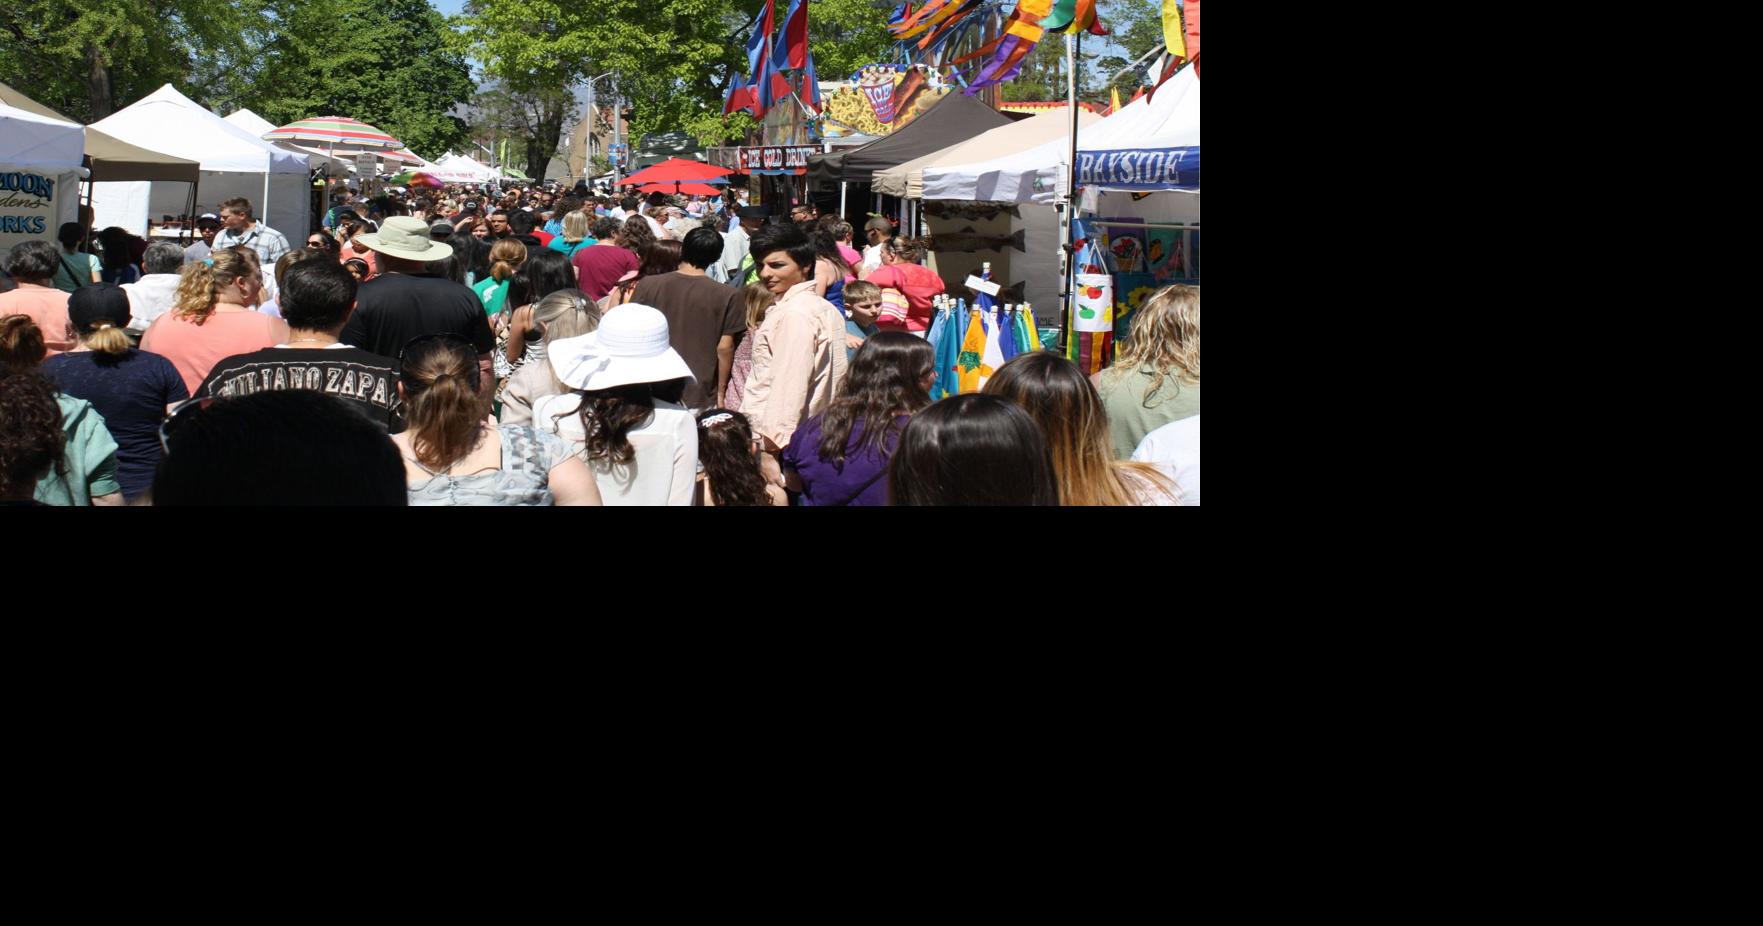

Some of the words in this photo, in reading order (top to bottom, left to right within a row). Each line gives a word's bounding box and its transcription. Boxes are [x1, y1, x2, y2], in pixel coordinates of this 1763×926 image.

[748, 149, 760, 168] ICE
[763, 148, 782, 168] COLD
[1080, 150, 1187, 184] BAYSIDE
[217, 366, 322, 398] MILIANO
[325, 367, 401, 410] ZAPA
